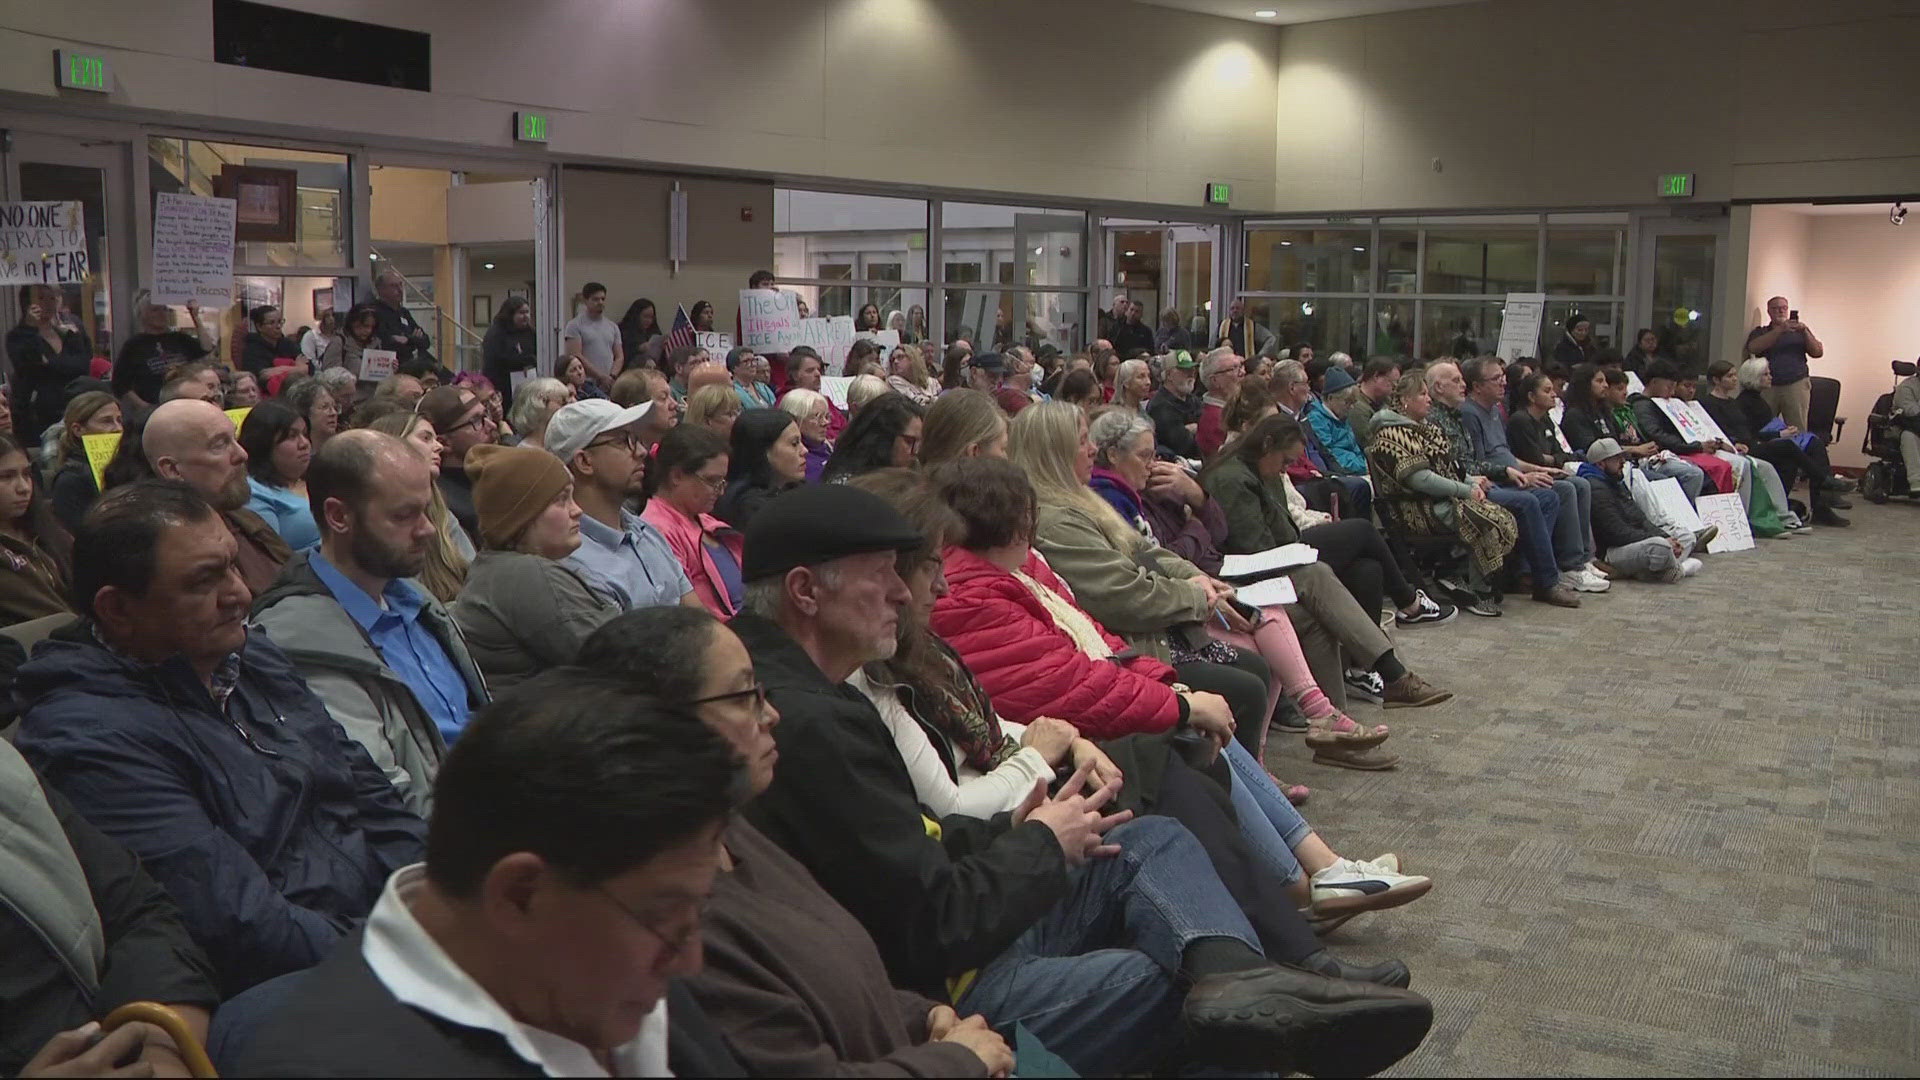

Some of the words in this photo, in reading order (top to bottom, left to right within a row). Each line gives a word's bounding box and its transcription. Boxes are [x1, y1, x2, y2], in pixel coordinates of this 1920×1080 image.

[71, 54, 103, 89] EXIT
[524, 114, 547, 140] EXIT
[1214, 184, 1229, 202] EXIT
[1664, 175, 1687, 195] EXIT
[0, 205, 24, 229] NO
[29, 203, 62, 228] ONE
[61, 230, 78, 247] TO
[24, 261, 38, 278] in
[41, 251, 88, 283] FEAR
[744, 295, 773, 317] The
[697, 332, 729, 348] ICE
[748, 332, 771, 347] ICE
